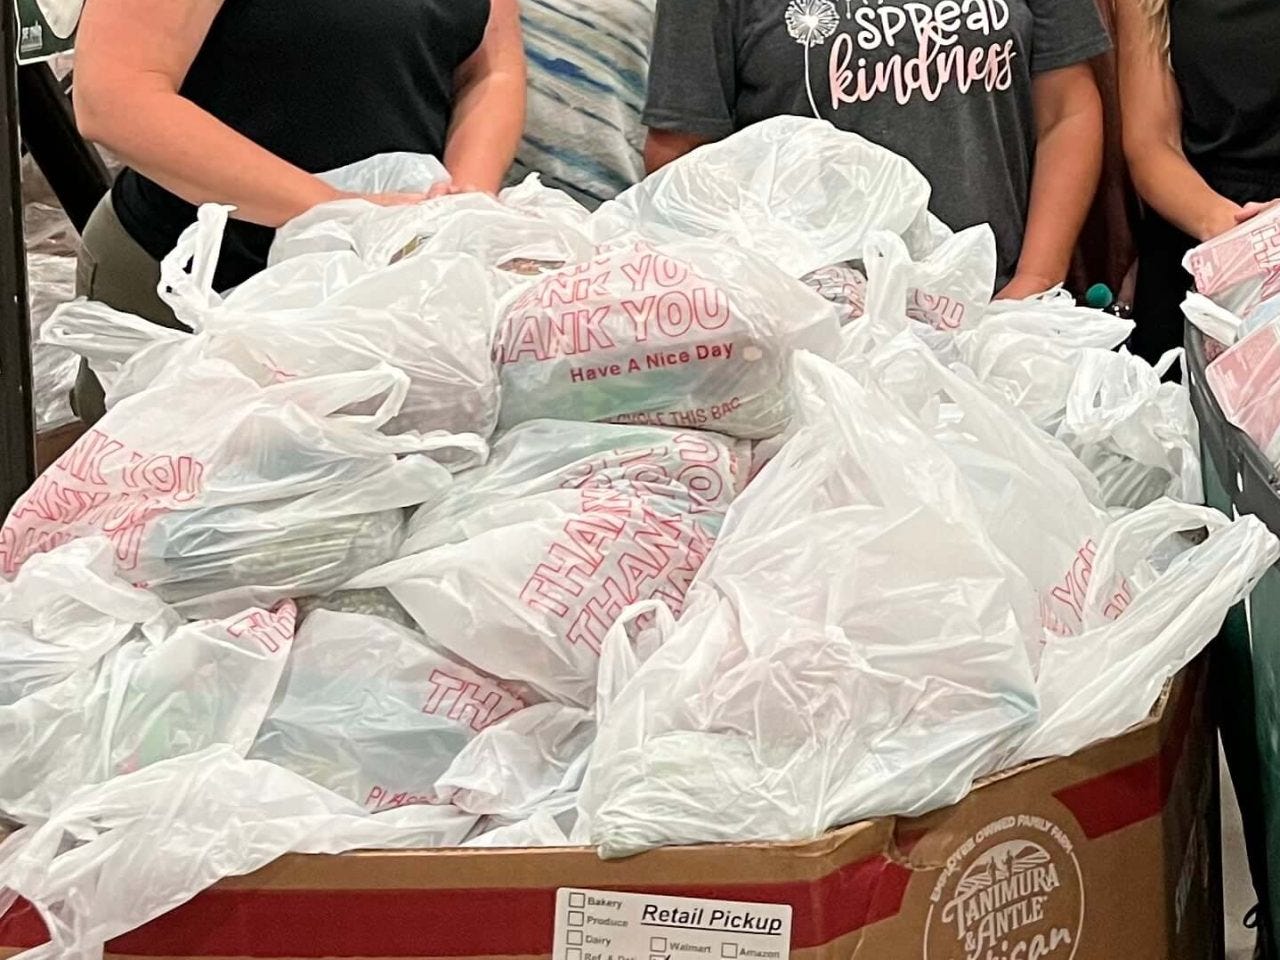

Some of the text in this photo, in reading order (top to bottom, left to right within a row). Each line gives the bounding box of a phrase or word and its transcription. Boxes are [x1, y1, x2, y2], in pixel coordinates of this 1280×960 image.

[829, 33, 1017, 110] kindness
[621, 287, 730, 342] YOU
[570, 342, 734, 383] Have A Nice Day
[587, 896, 623, 910] Bakery
[641, 903, 782, 935] Retail Pickup
[941, 863, 1060, 940] TANIMURA
[586, 915, 629, 927] Produce
[967, 897, 1044, 960] ANTLE
[585, 934, 611, 947] Dairy
[669, 941, 780, 958] Walmart Amazon
